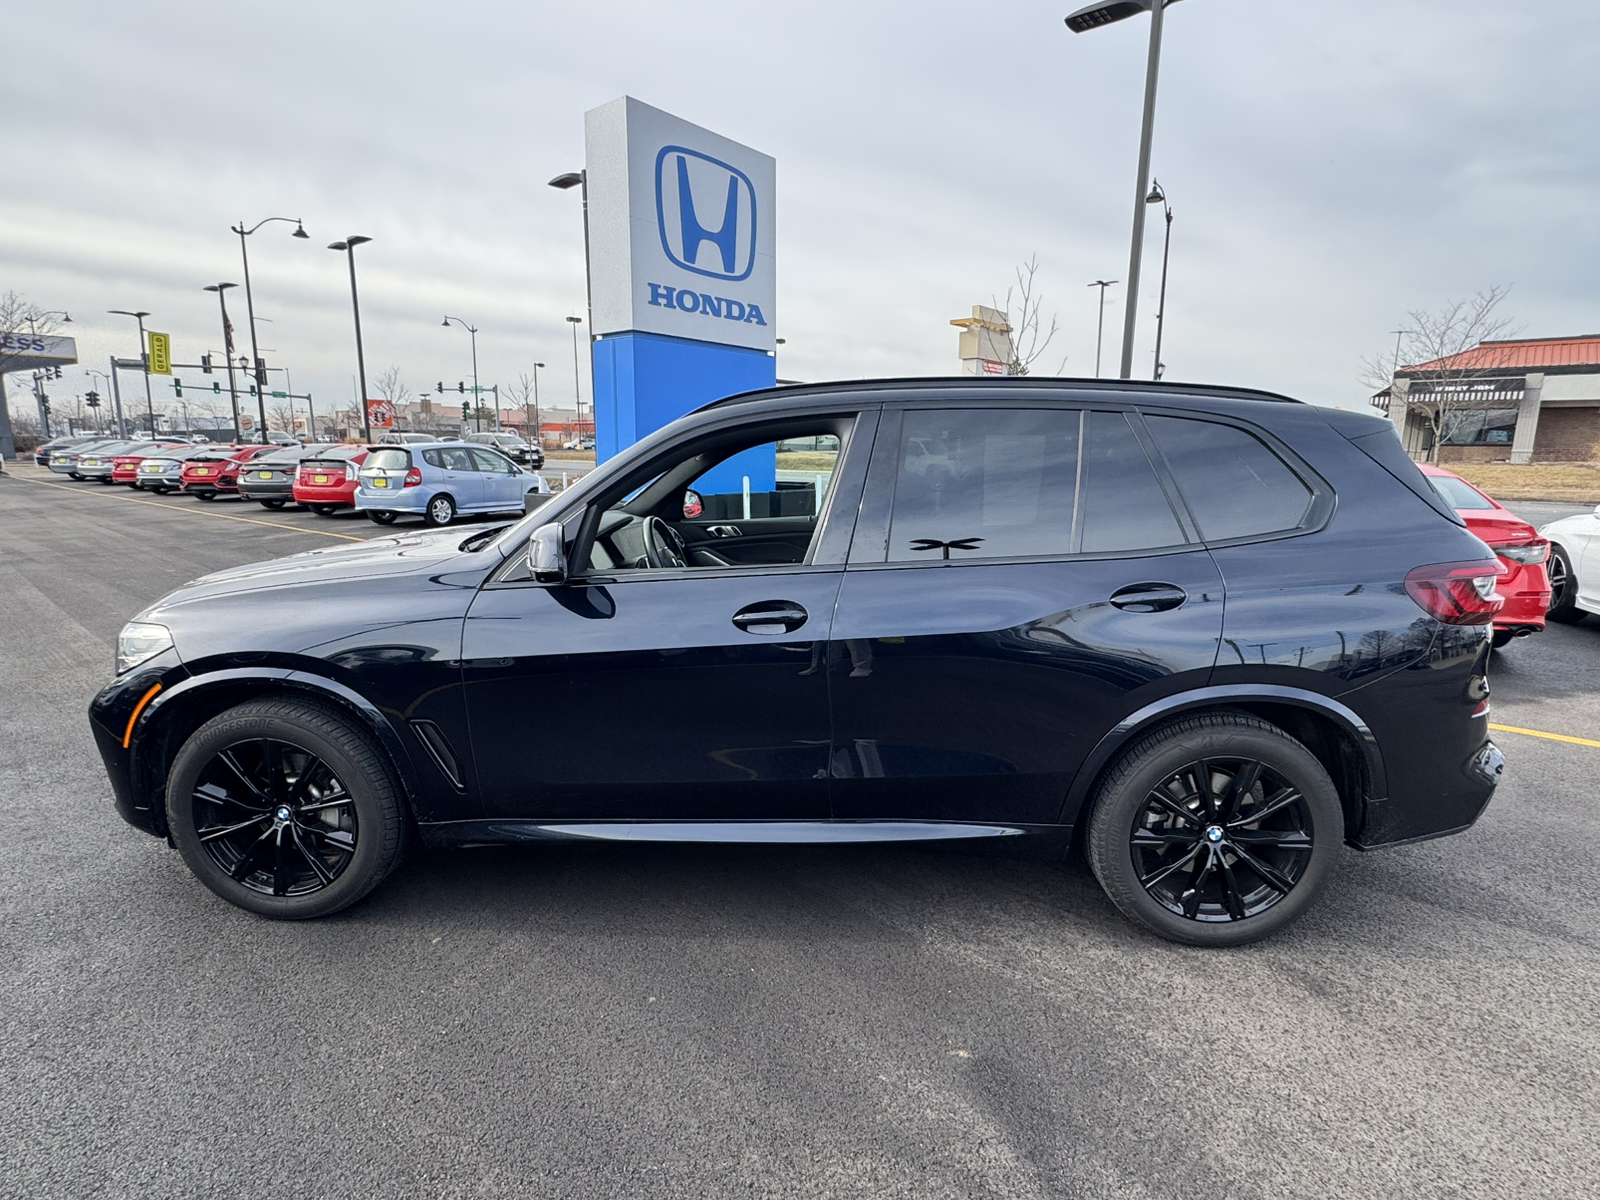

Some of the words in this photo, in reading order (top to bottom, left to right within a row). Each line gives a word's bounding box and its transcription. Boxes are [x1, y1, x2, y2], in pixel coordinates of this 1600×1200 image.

[647, 282, 768, 327] HONDA
[155, 337, 165, 370] GERALD
[193, 719, 275, 749] BRIDGESTONE
